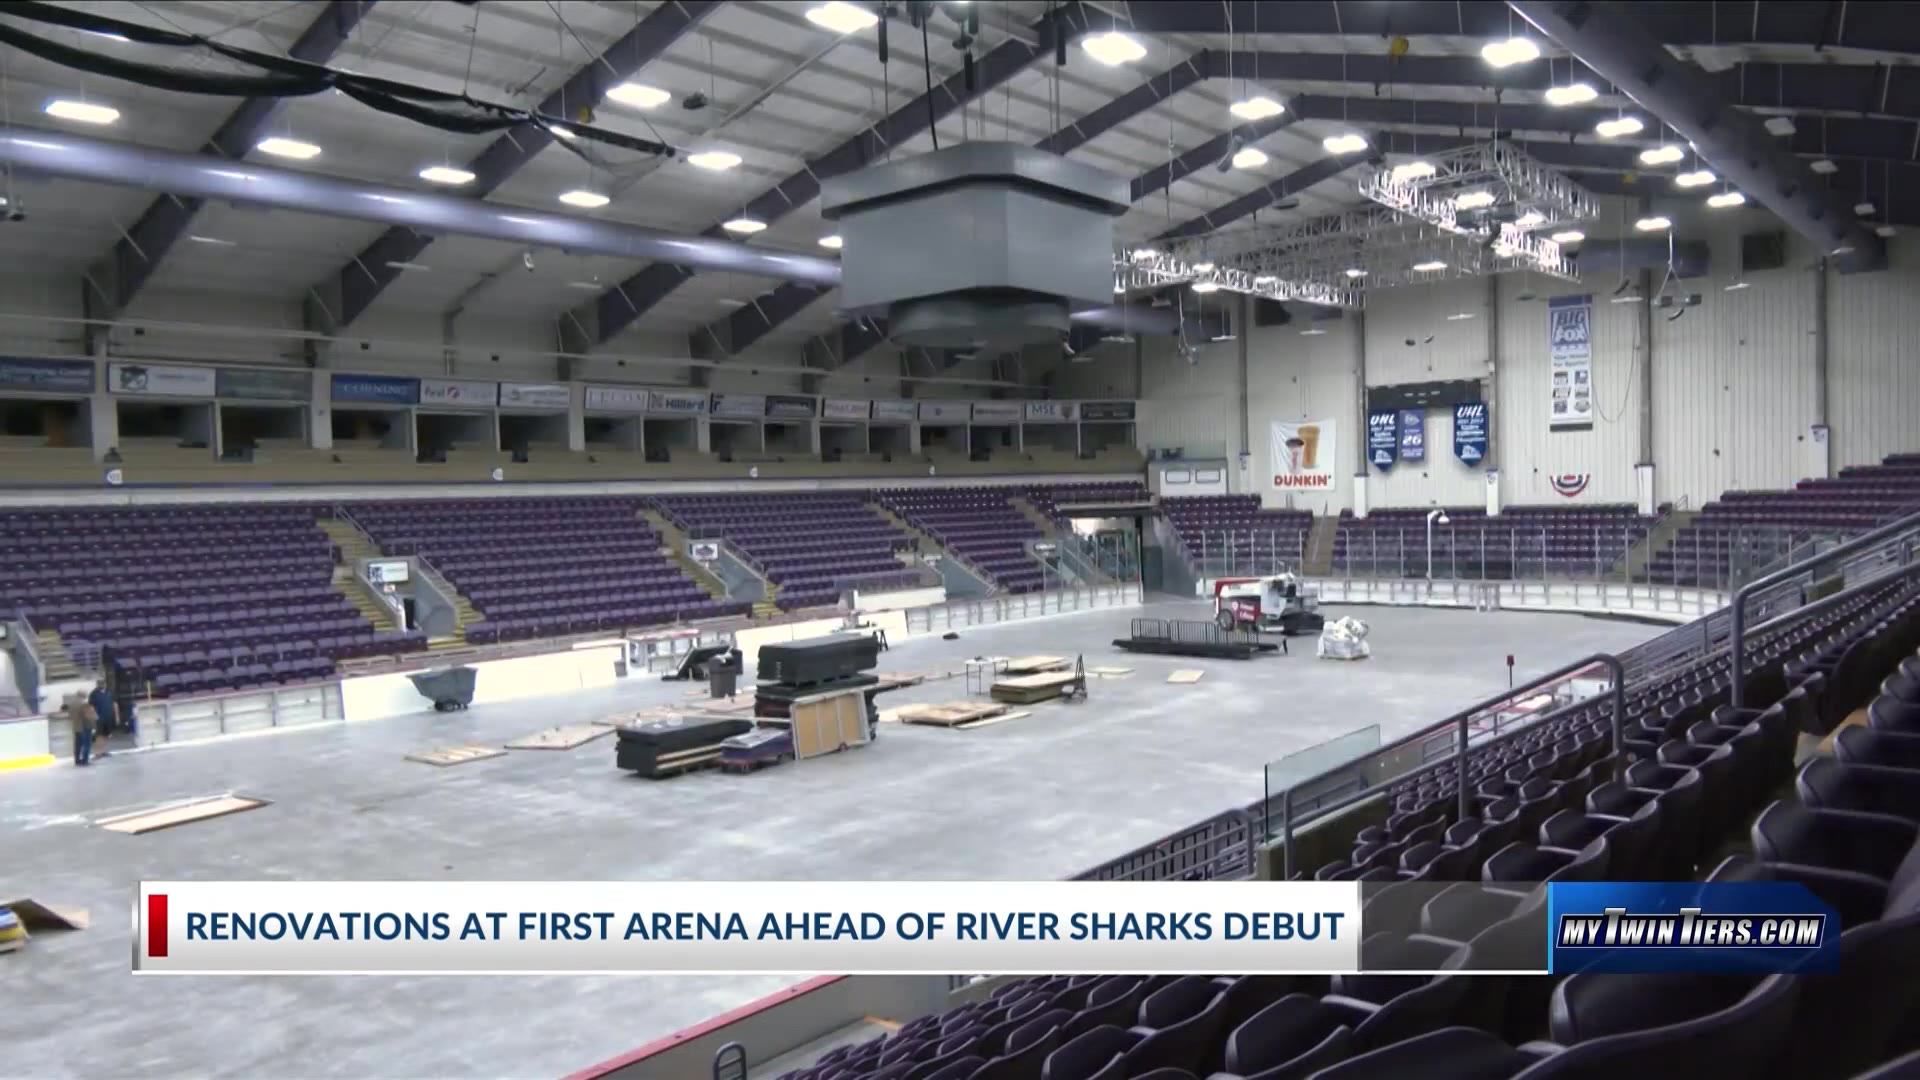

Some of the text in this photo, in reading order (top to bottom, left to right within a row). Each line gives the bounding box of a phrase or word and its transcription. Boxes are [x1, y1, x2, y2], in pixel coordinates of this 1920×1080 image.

[1555, 325, 1585, 343] FOX
[1031, 403, 1056, 416] MSE
[1457, 404, 1483, 418] UHL
[1370, 413, 1395, 426] UHL
[1274, 473, 1332, 487] DUNKIN'
